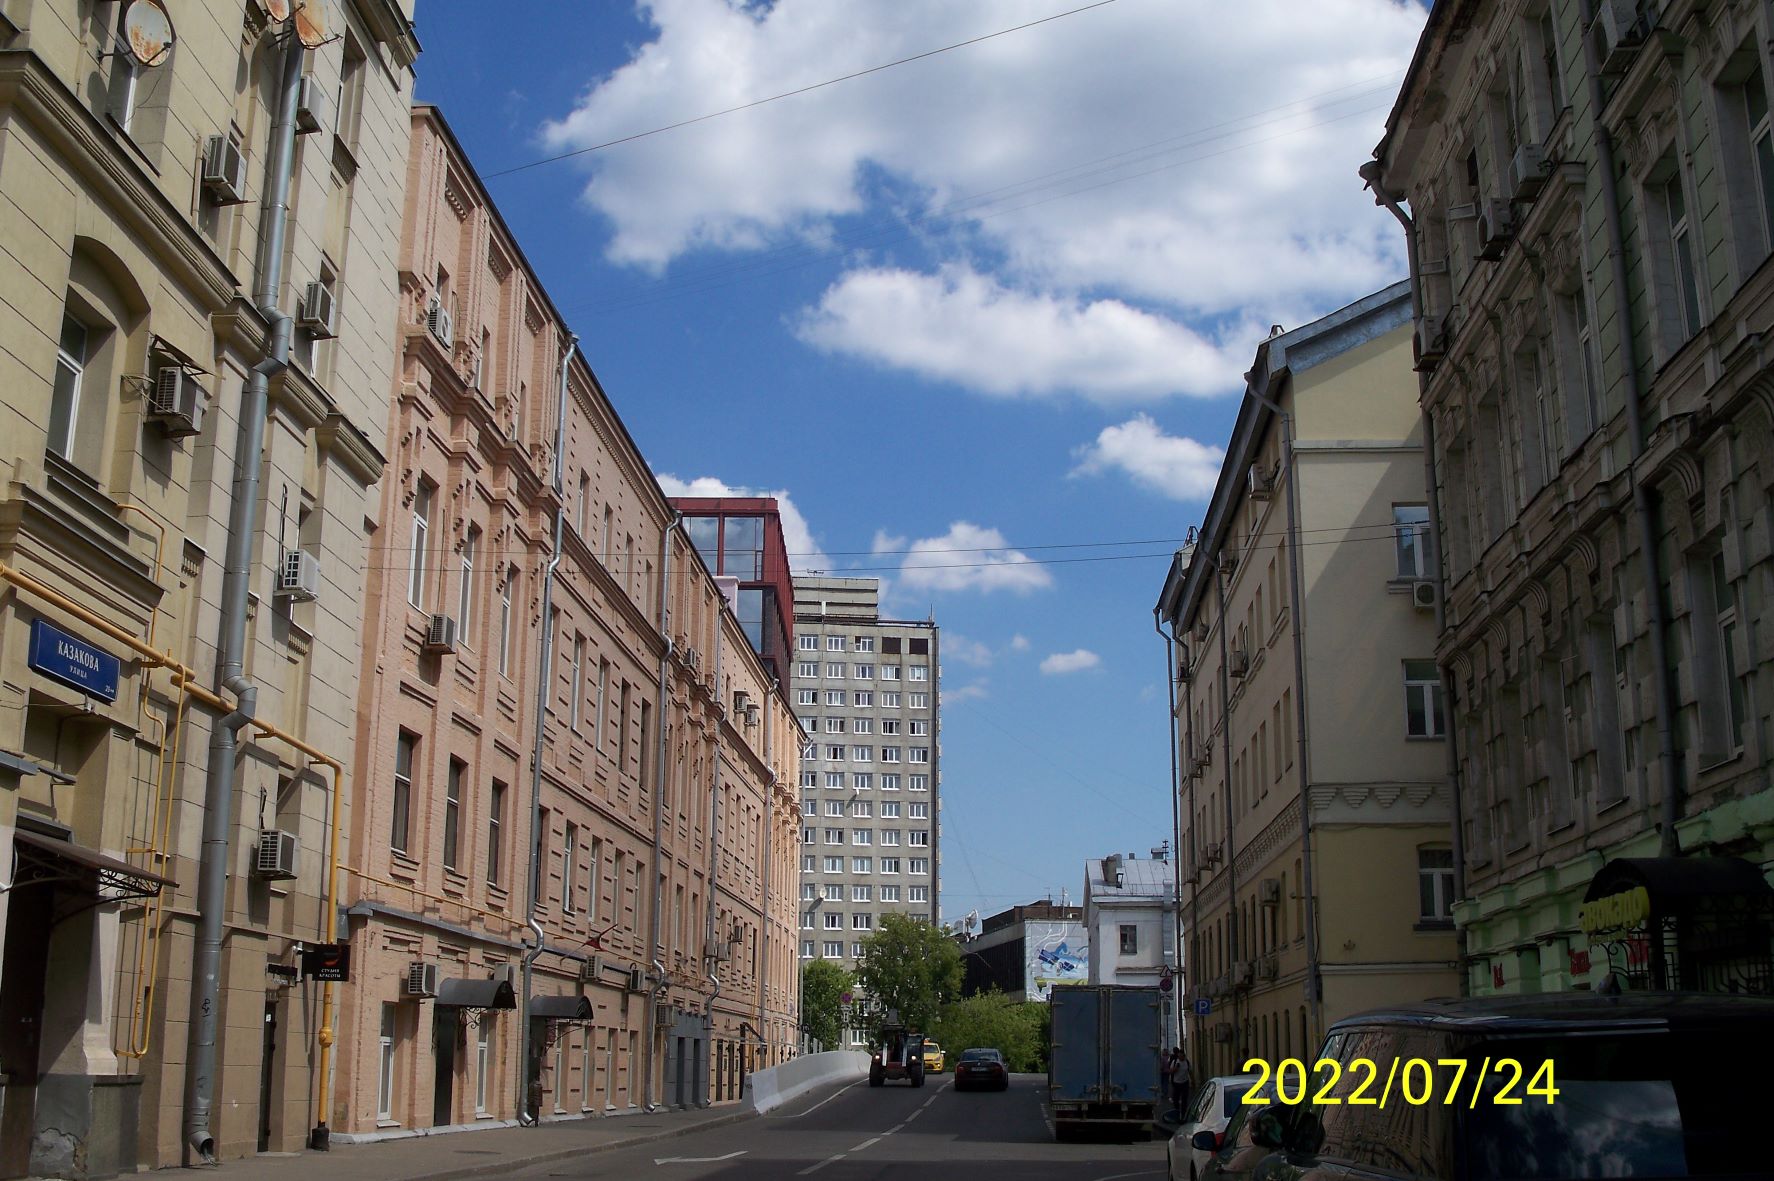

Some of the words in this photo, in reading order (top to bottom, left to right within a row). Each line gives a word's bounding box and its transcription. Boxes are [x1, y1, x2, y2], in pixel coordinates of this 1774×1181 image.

[58, 640, 99, 672] КАЗАКОВА
[69, 665, 88, 679] УЛИЦА
[1199, 1000, 1208, 1013] P
